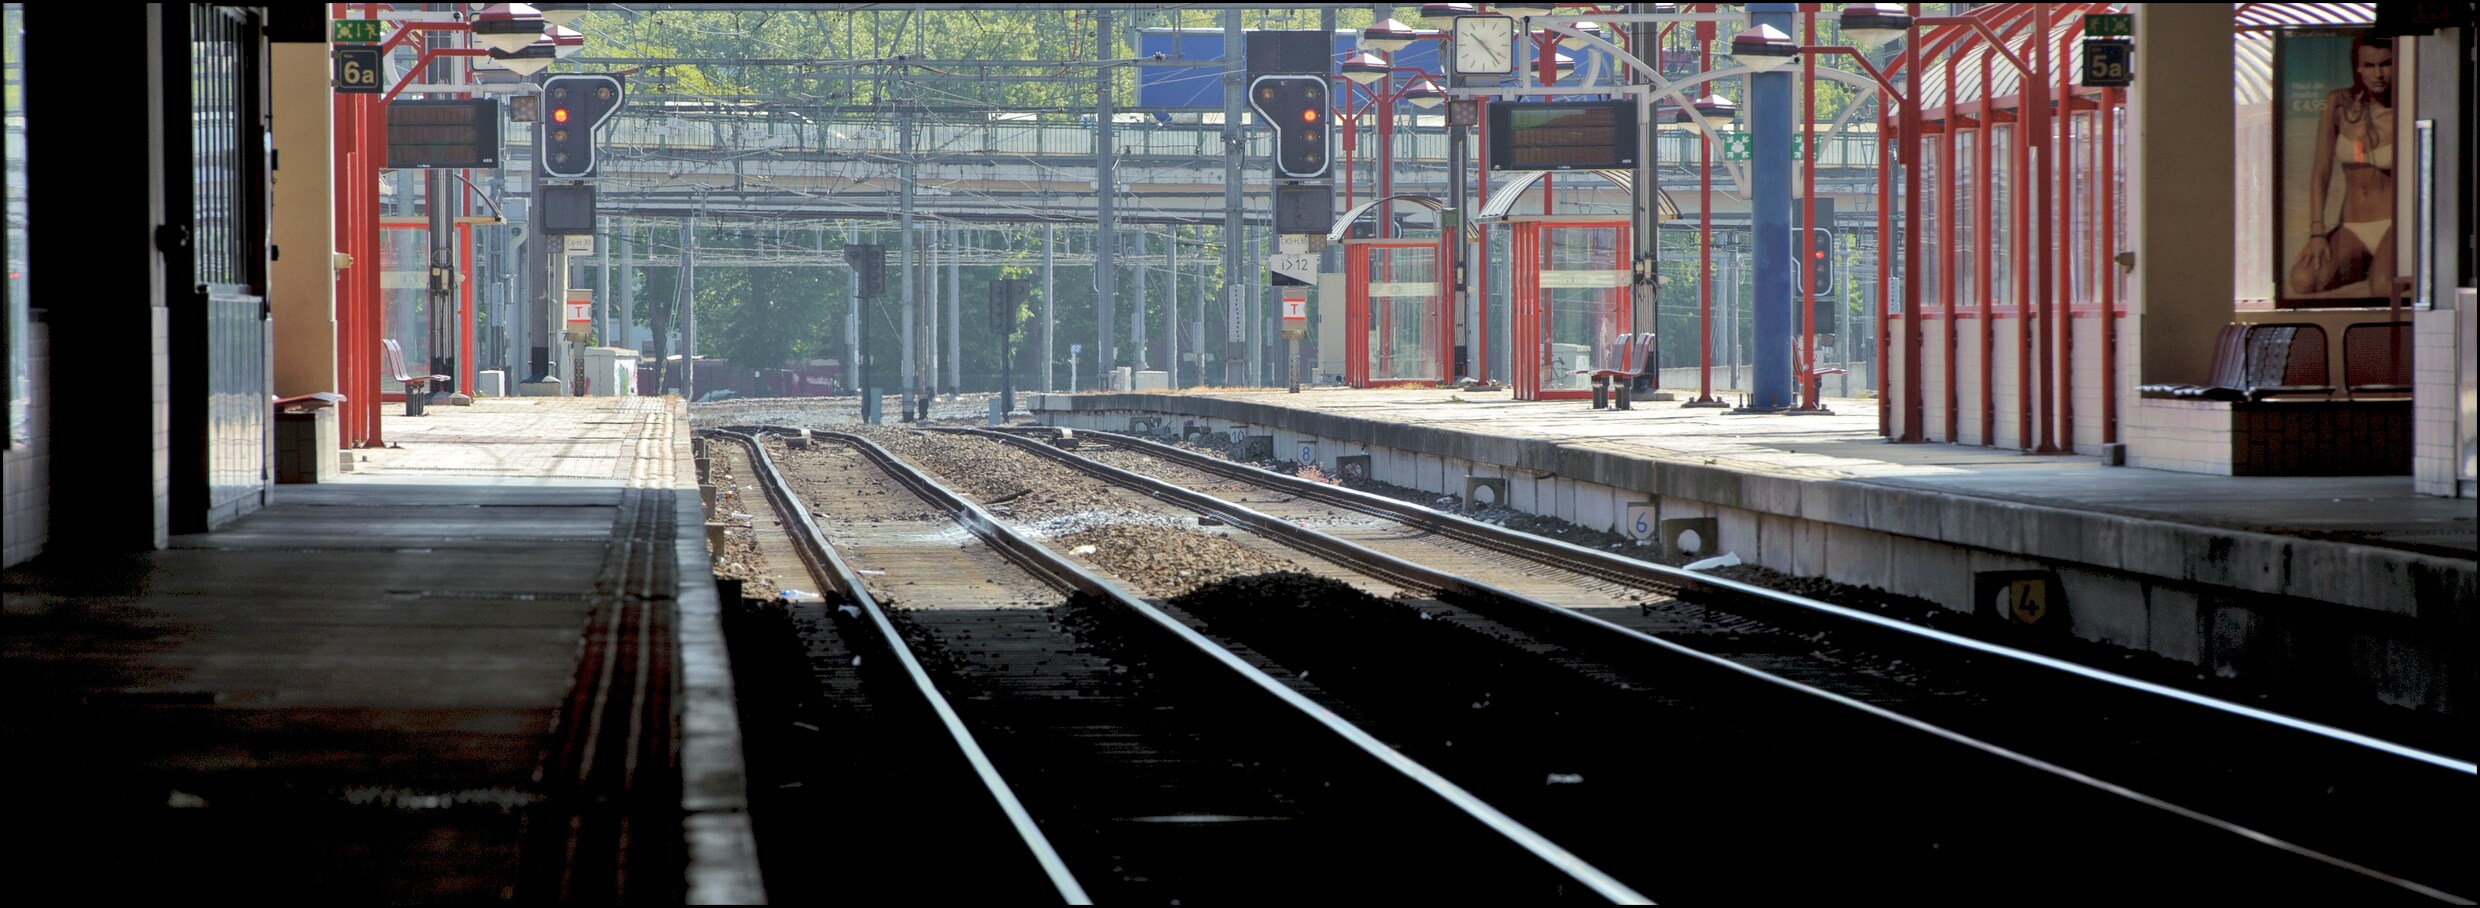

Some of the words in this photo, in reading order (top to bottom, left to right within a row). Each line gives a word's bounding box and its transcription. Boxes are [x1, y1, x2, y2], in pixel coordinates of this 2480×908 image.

[344, 60, 376, 84] 6a
[2092, 54, 2122, 78] 5a
[575, 306, 582, 318] T
[1291, 303, 1298, 315] T
[1231, 430, 1245, 442] 10
[1302, 446, 1310, 461] 8
[1636, 511, 1648, 533] 6
[2019, 584, 2040, 616] 4
